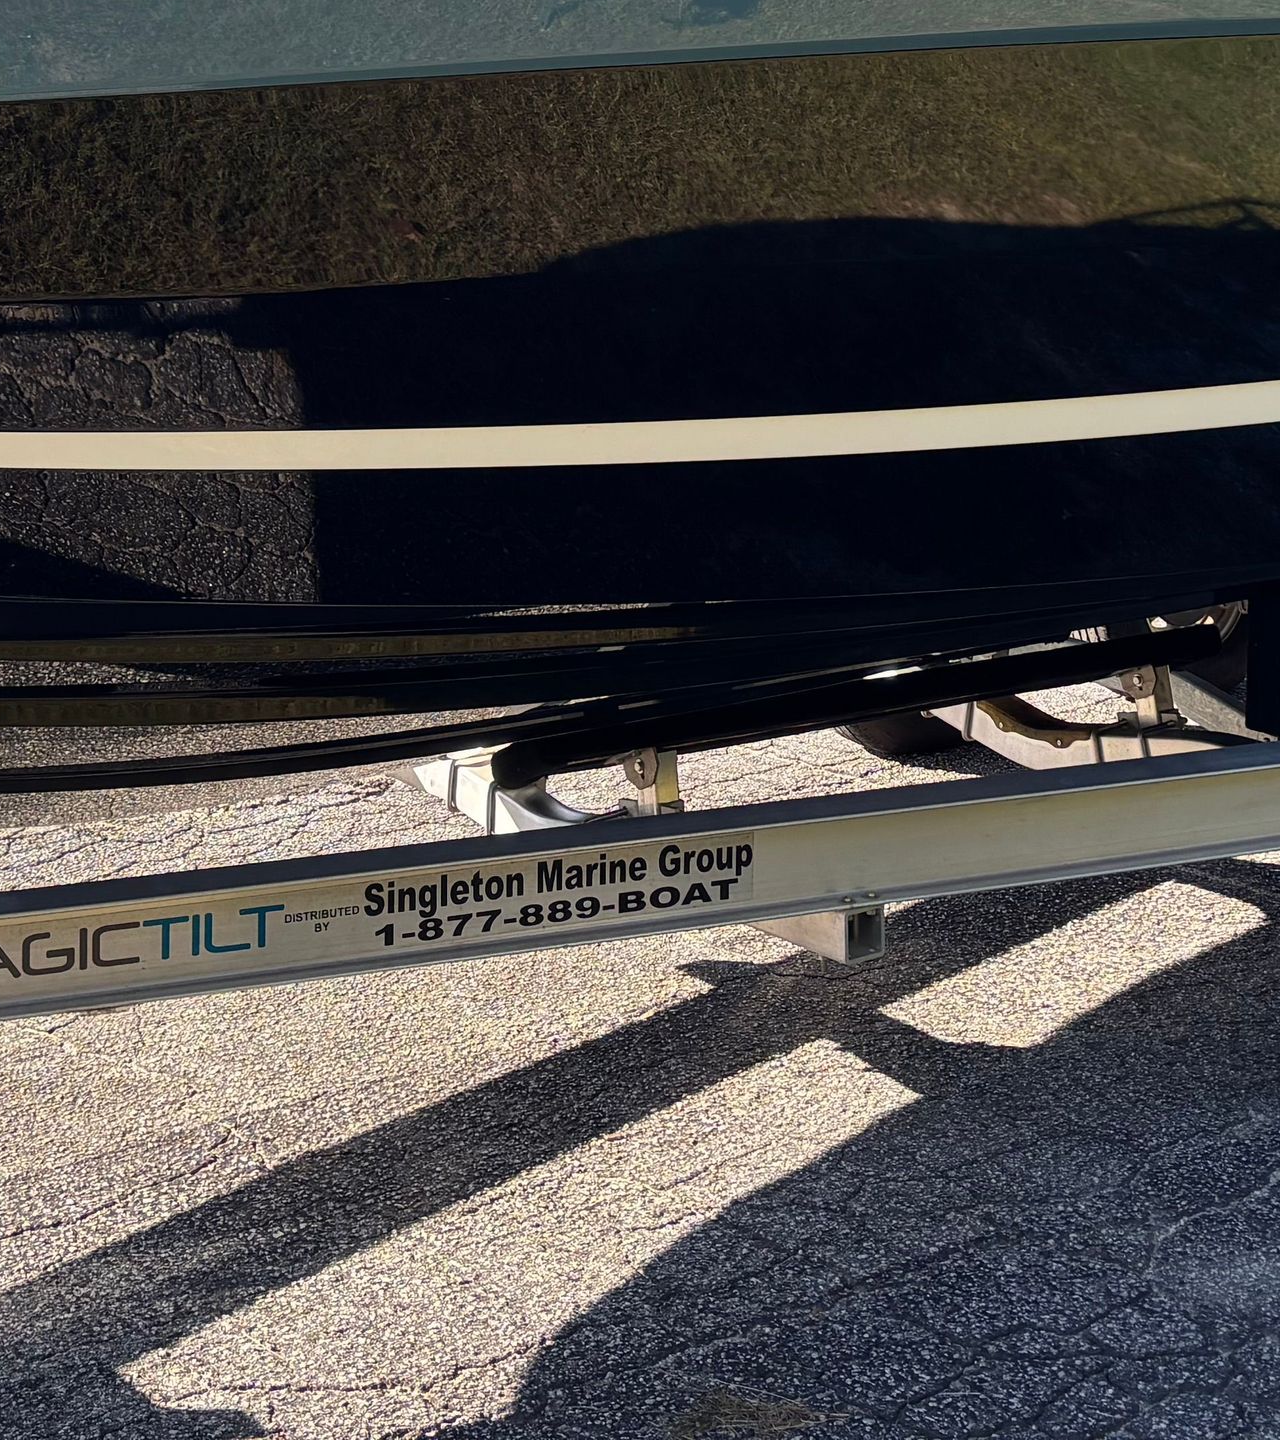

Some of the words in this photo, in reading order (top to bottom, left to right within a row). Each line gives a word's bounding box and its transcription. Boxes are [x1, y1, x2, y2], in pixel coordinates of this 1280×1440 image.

[363, 869, 524, 917] Singleton
[536, 853, 648, 894] Marine
[658, 842, 754, 877] Group
[284, 904, 360, 924] DISTRIBUTED
[314, 921, 331, 933] BY
[374, 877, 739, 947] 1-877-889-BOAT
